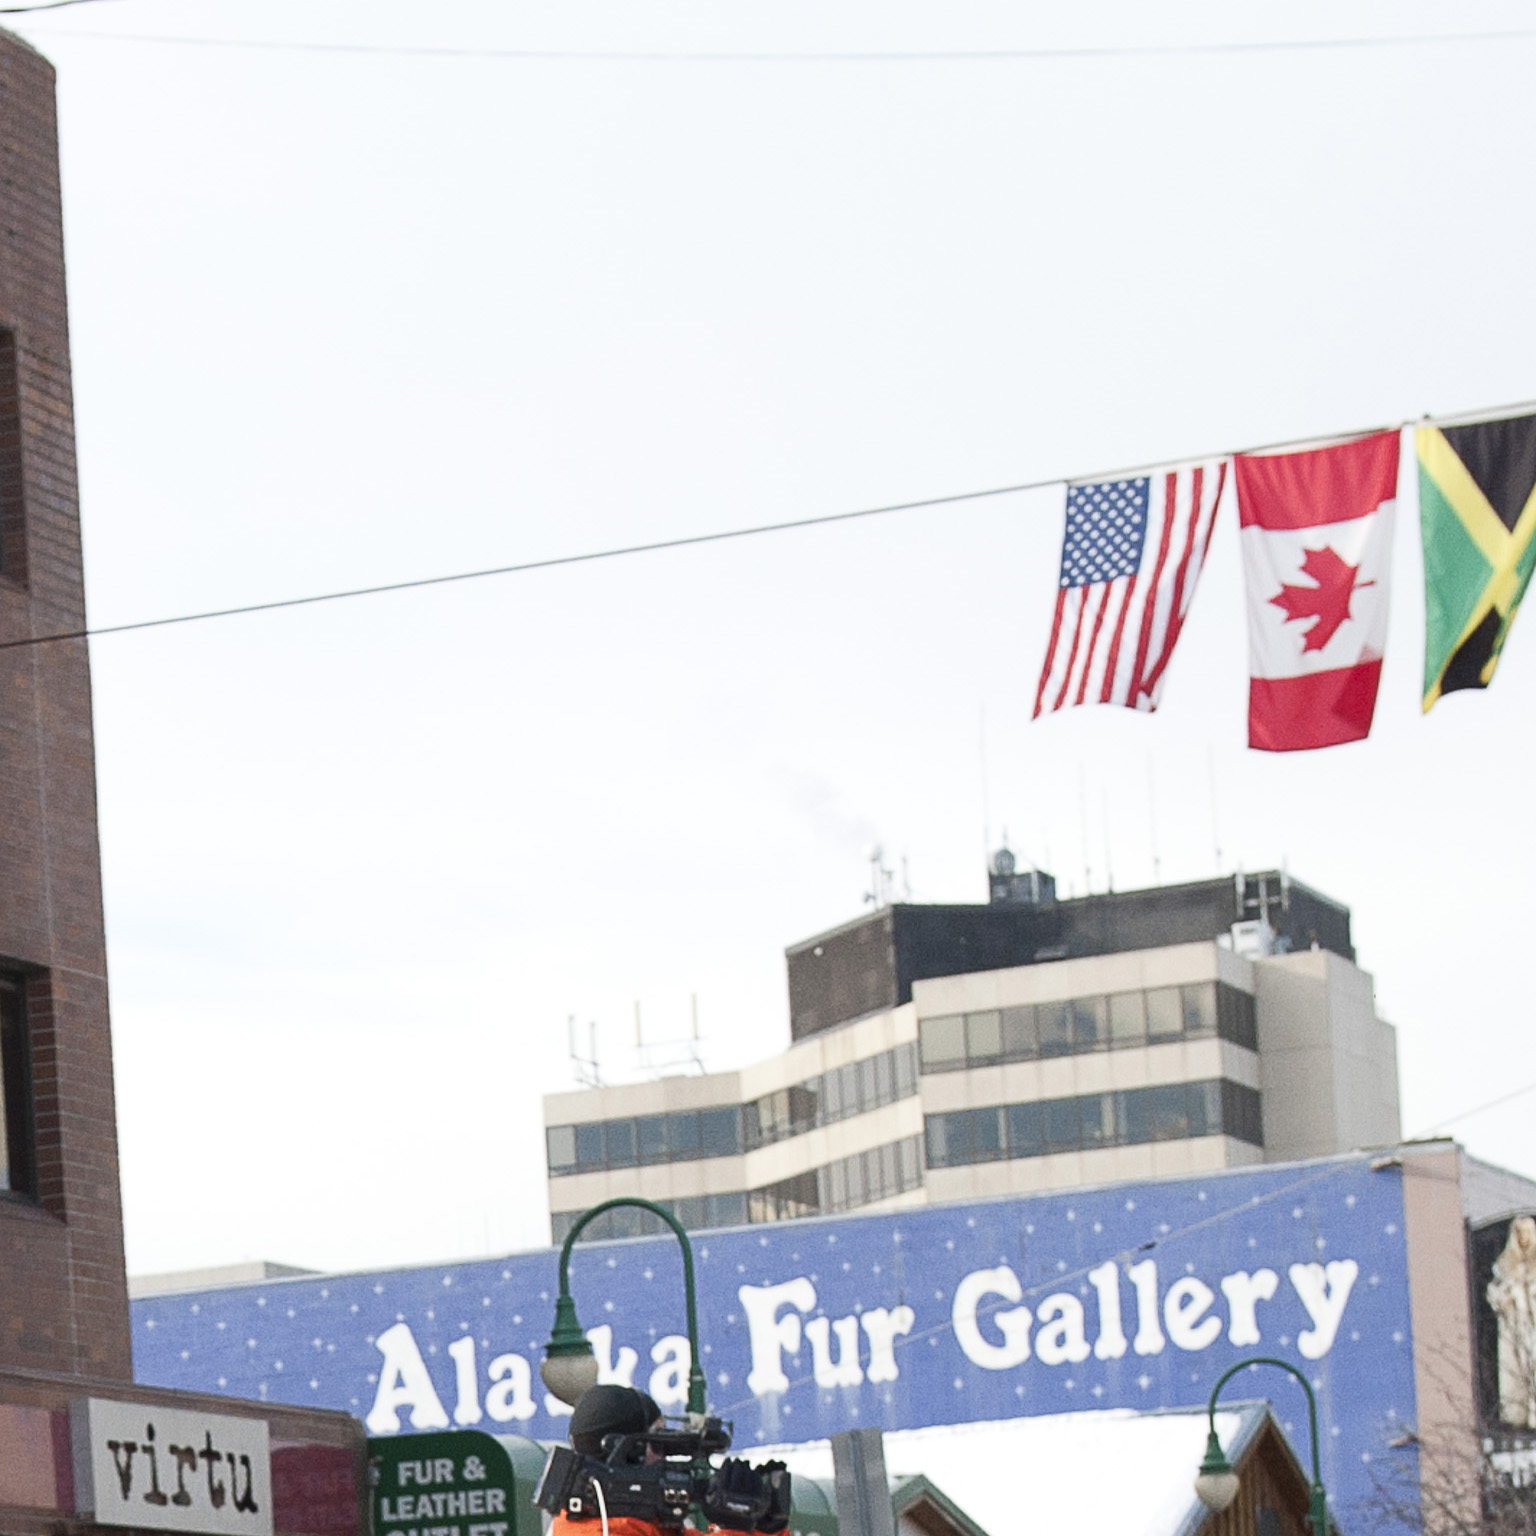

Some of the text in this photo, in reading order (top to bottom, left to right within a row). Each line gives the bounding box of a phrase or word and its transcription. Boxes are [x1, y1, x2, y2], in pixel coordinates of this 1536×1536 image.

[366, 1259, 1358, 1436] Alaka Fur Gallery
[107, 1422, 258, 1514] virtu
[398, 1456, 486, 1486] FUR &
[382, 1490, 506, 1521] LEATHER
